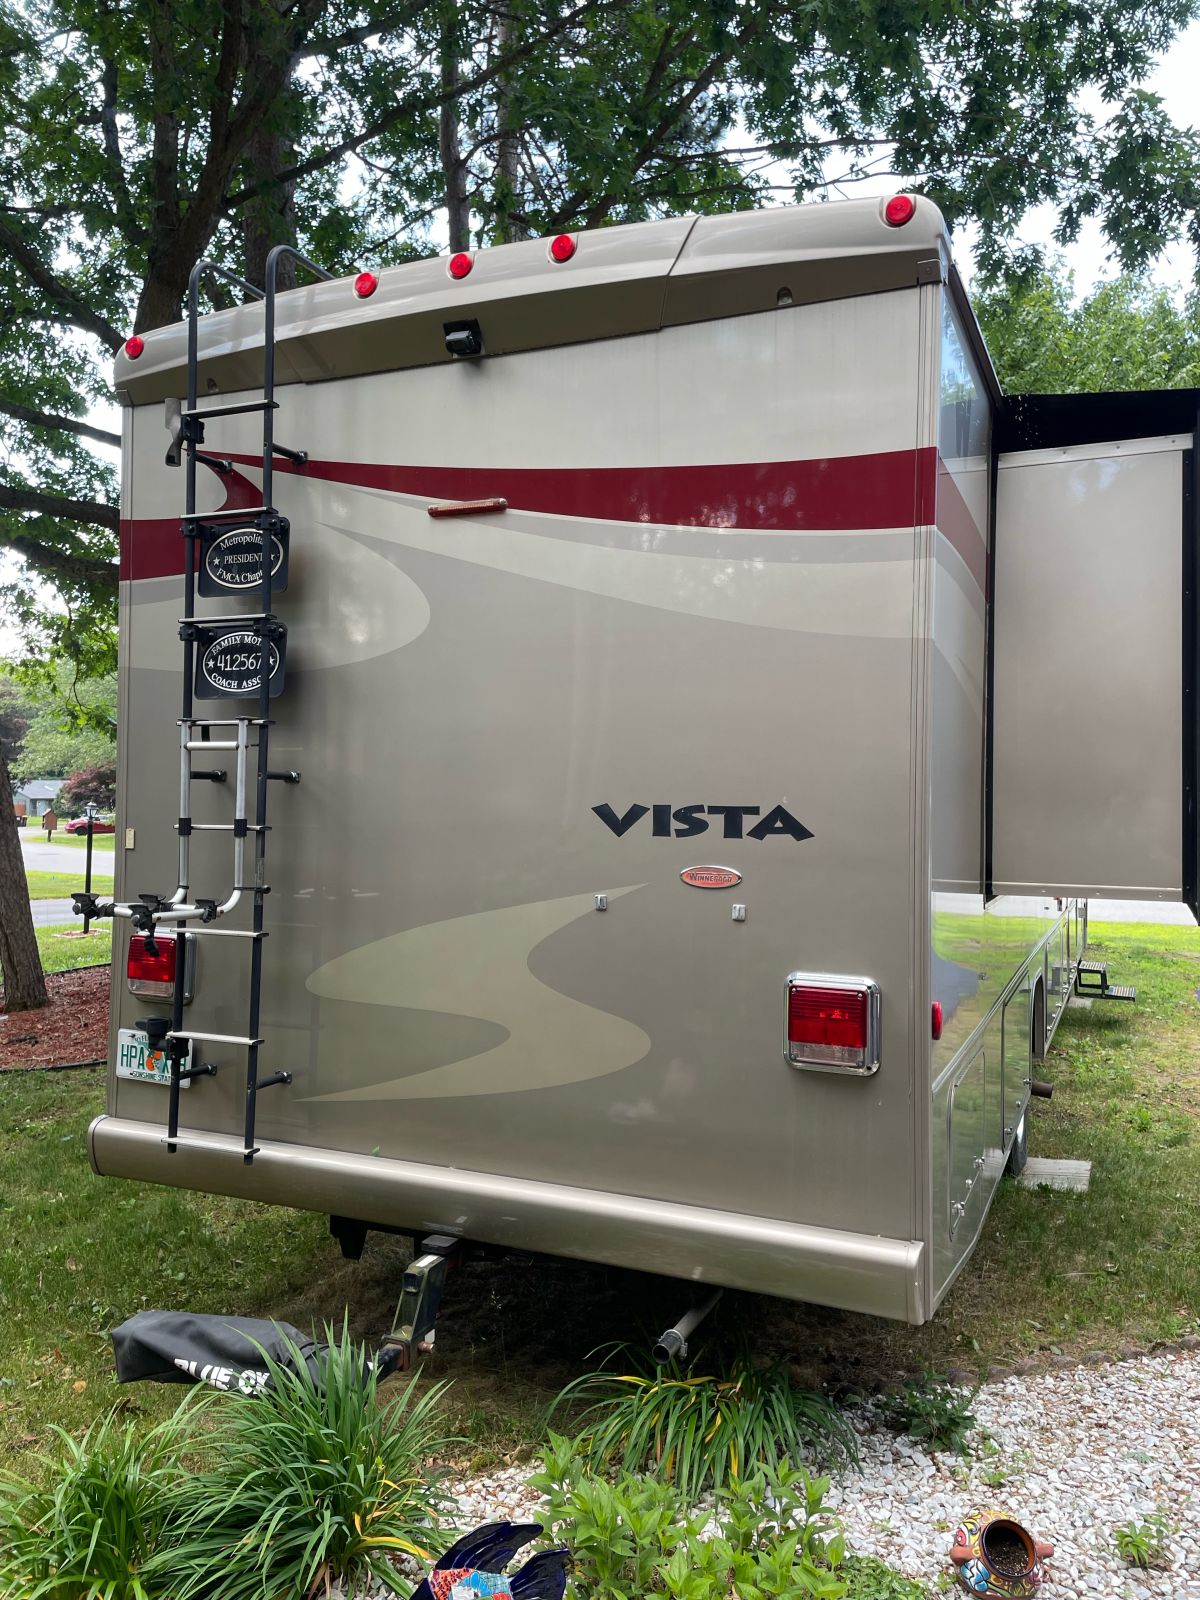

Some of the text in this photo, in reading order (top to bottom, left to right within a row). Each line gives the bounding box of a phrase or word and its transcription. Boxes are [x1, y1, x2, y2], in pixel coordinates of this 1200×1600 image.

[224, 553, 262, 564] PRESIDENT
[216, 568, 262, 583] FMCA Chapt
[211, 635, 262, 655] FAMILY MOT
[217, 653, 261, 671] 412567
[211, 672, 238, 689] COACH
[590, 802, 816, 842] VISTA
[120, 1043, 145, 1069] HPA
[133, 1071, 171, 1082] SUNSHINE STAT
